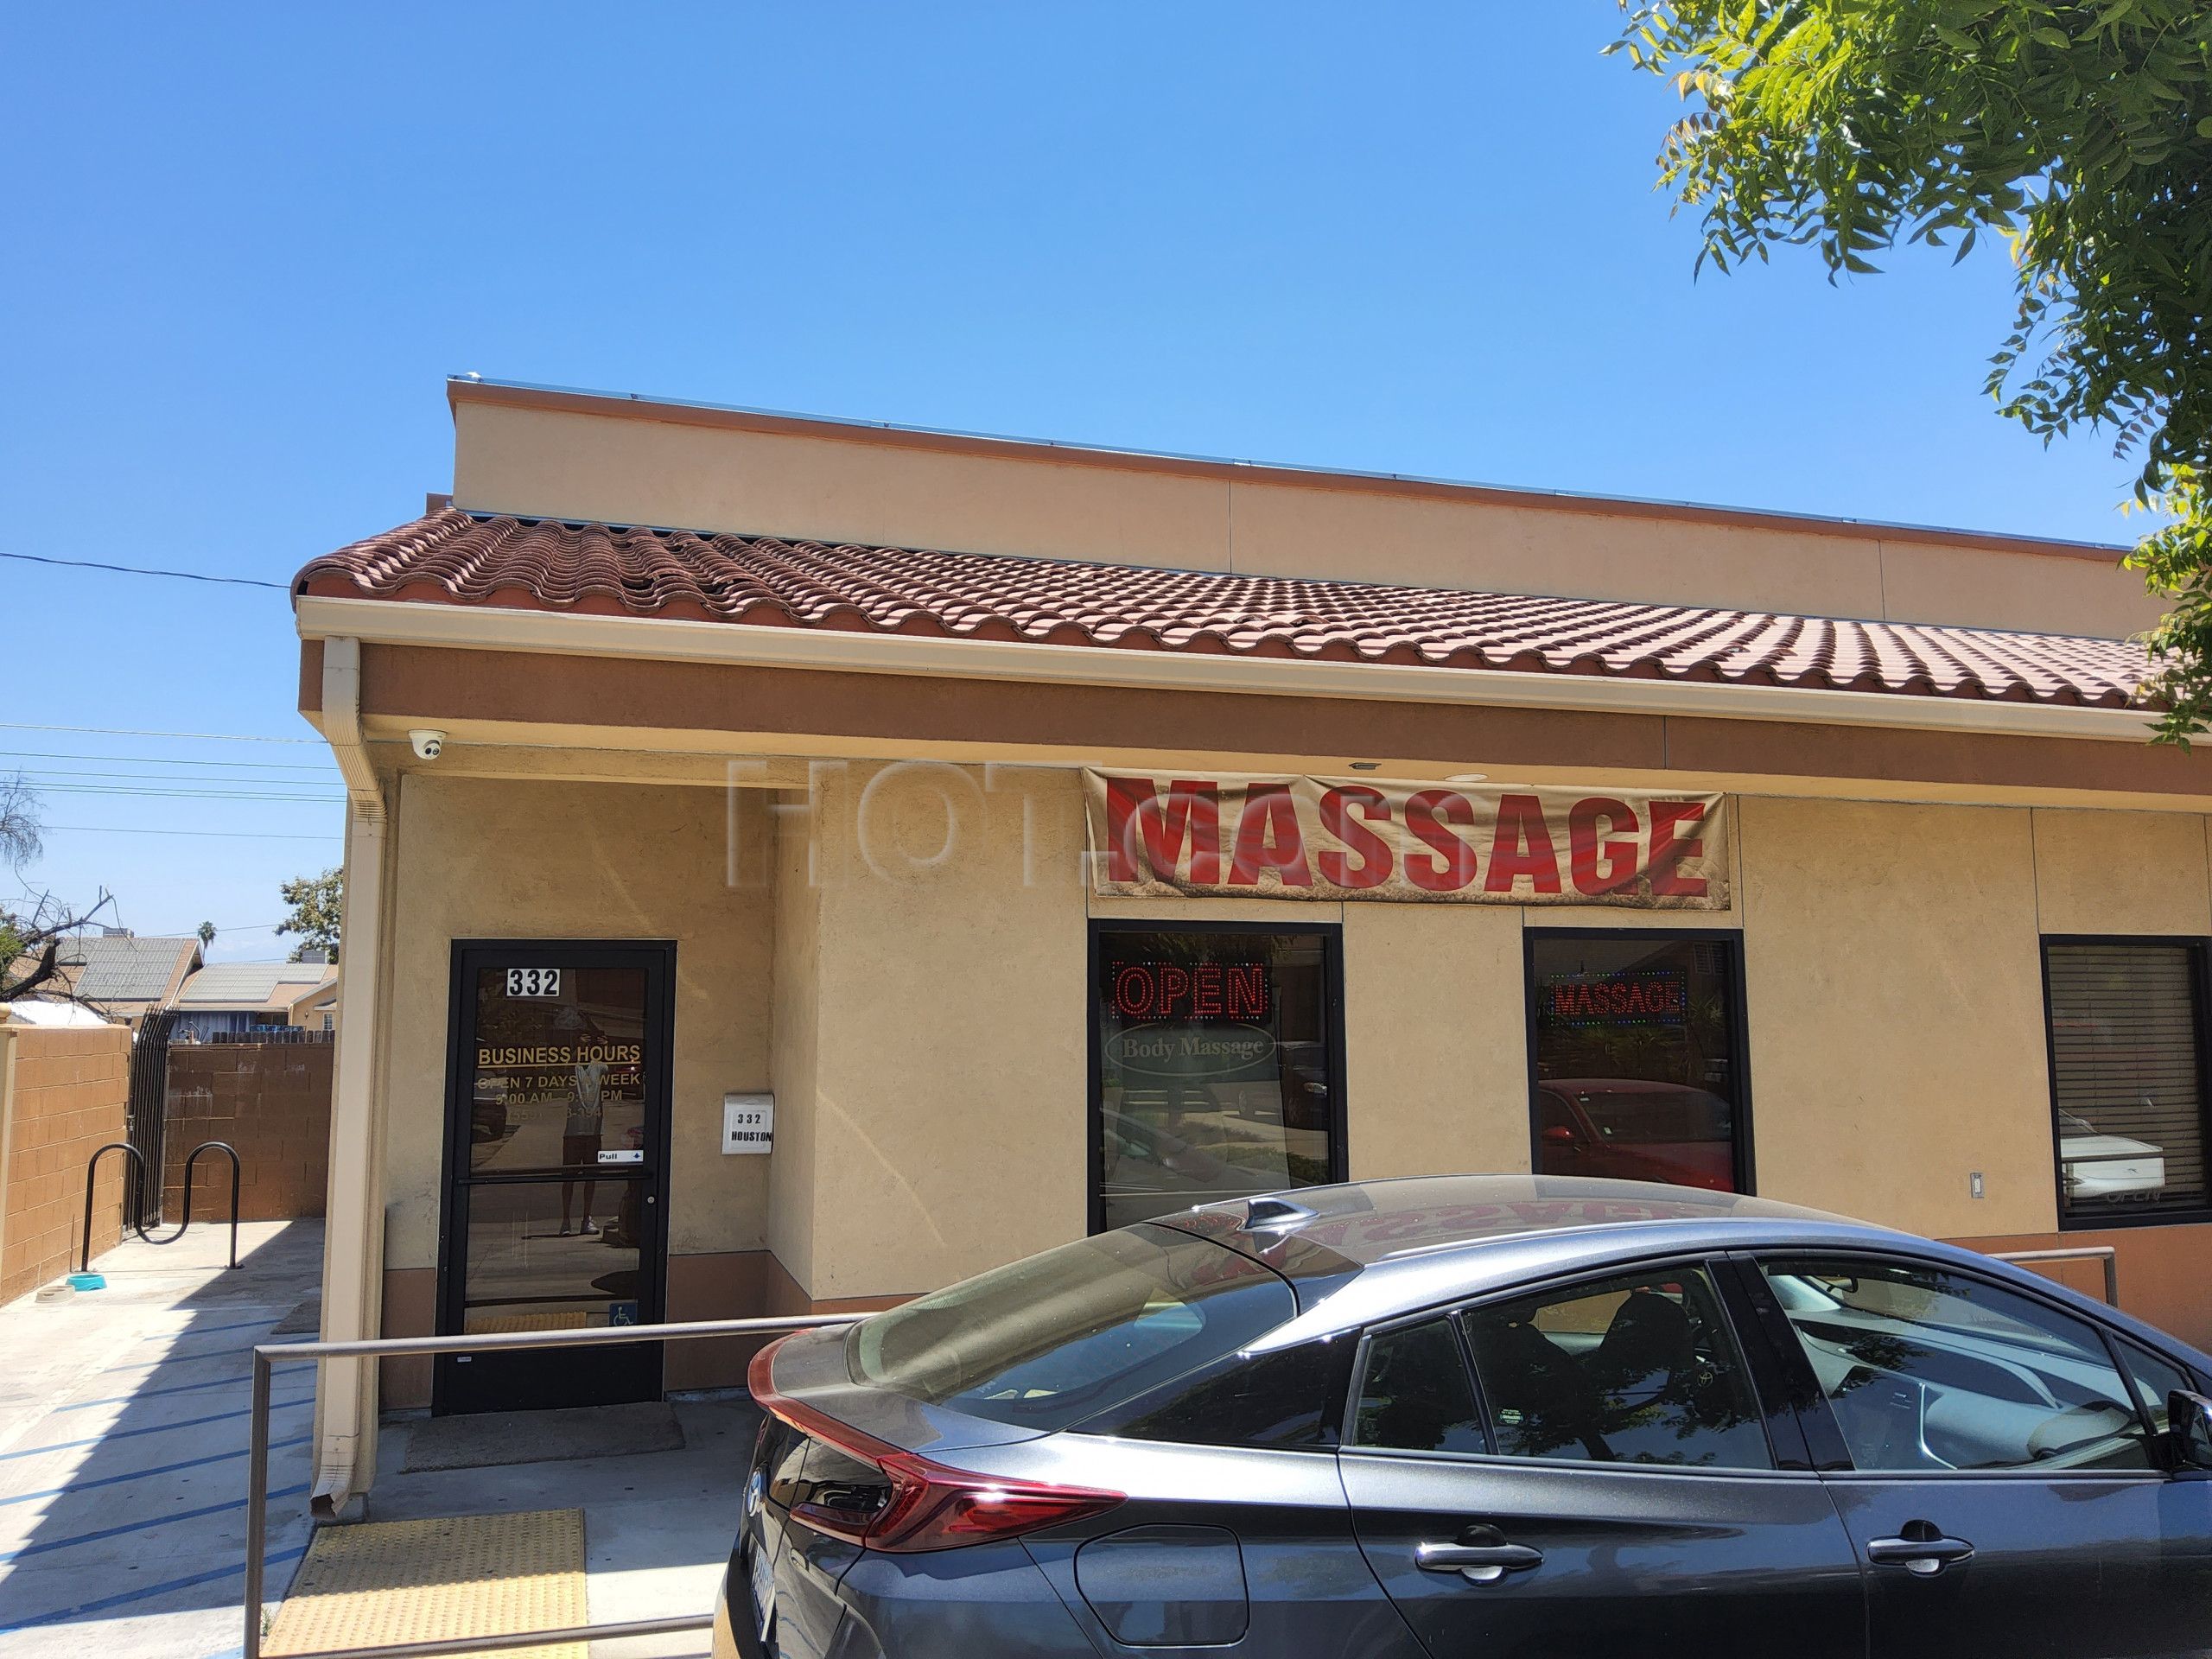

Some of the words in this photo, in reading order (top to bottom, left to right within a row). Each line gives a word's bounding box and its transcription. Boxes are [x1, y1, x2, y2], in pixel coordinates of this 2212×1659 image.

[1106, 777, 1710, 899] MASSAGE
[510, 969, 558, 995] 332
[1116, 966, 1264, 1016] OPEN
[1554, 981, 1681, 1015] MASSAGE
[479, 1046, 571, 1065] BUSINESS
[577, 1045, 641, 1063] HOURS
[1122, 1039, 1175, 1062] Body
[1179, 1037, 1265, 1061] Massage
[478, 1076, 520, 1090] OPEN
[525, 1077, 533, 1088] 7
[538, 1075, 577, 1088] DAYS
[598, 1073, 641, 1086] WEEK
[530, 1091, 553, 1103] AM
[601, 1090, 623, 1102] PM
[737, 1113, 761, 1124] 332
[731, 1130, 772, 1142] HOUSTON
